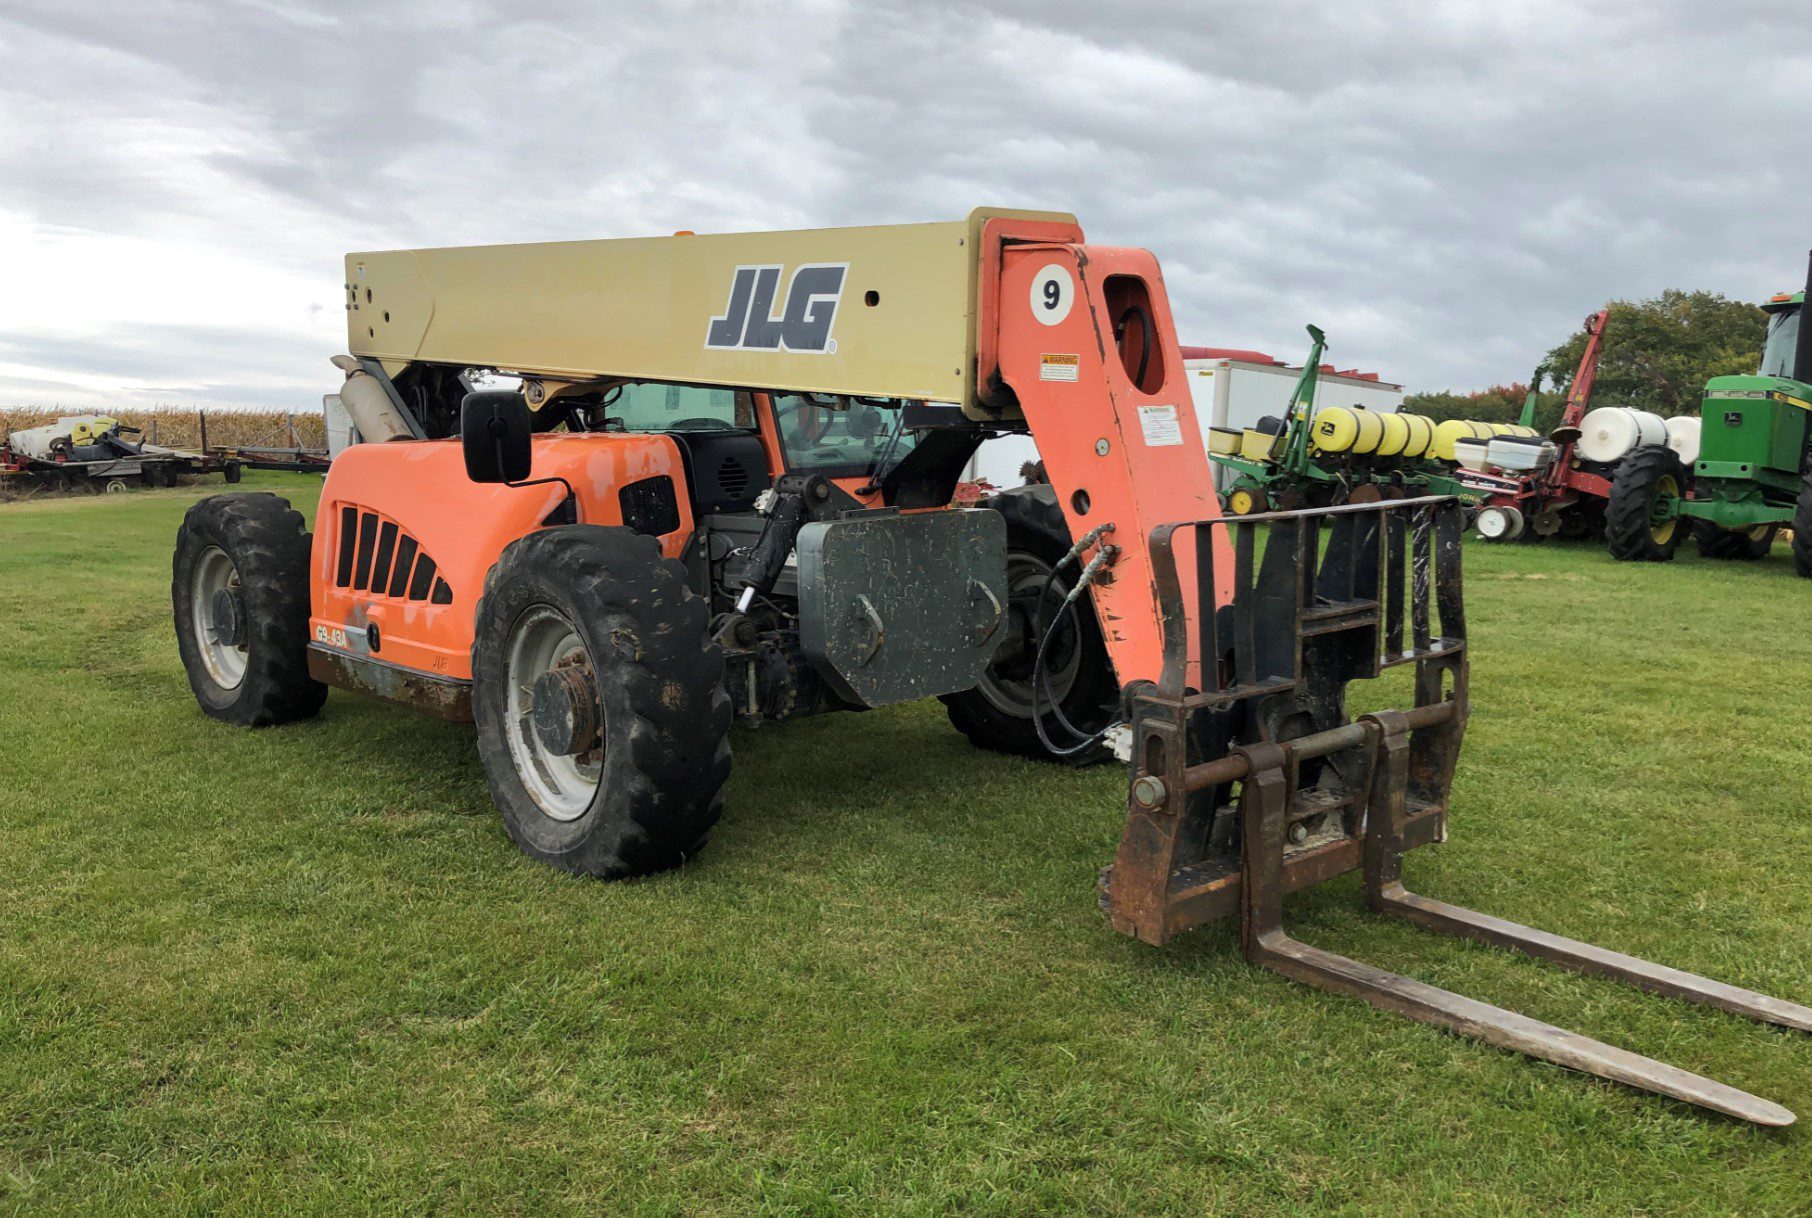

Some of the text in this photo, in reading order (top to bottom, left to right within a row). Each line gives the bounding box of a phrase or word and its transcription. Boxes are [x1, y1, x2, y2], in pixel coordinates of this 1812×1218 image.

[704, 262, 849, 354] JLG
[1043, 280, 1060, 310] 9
[1049, 356, 1077, 365] WARNING
